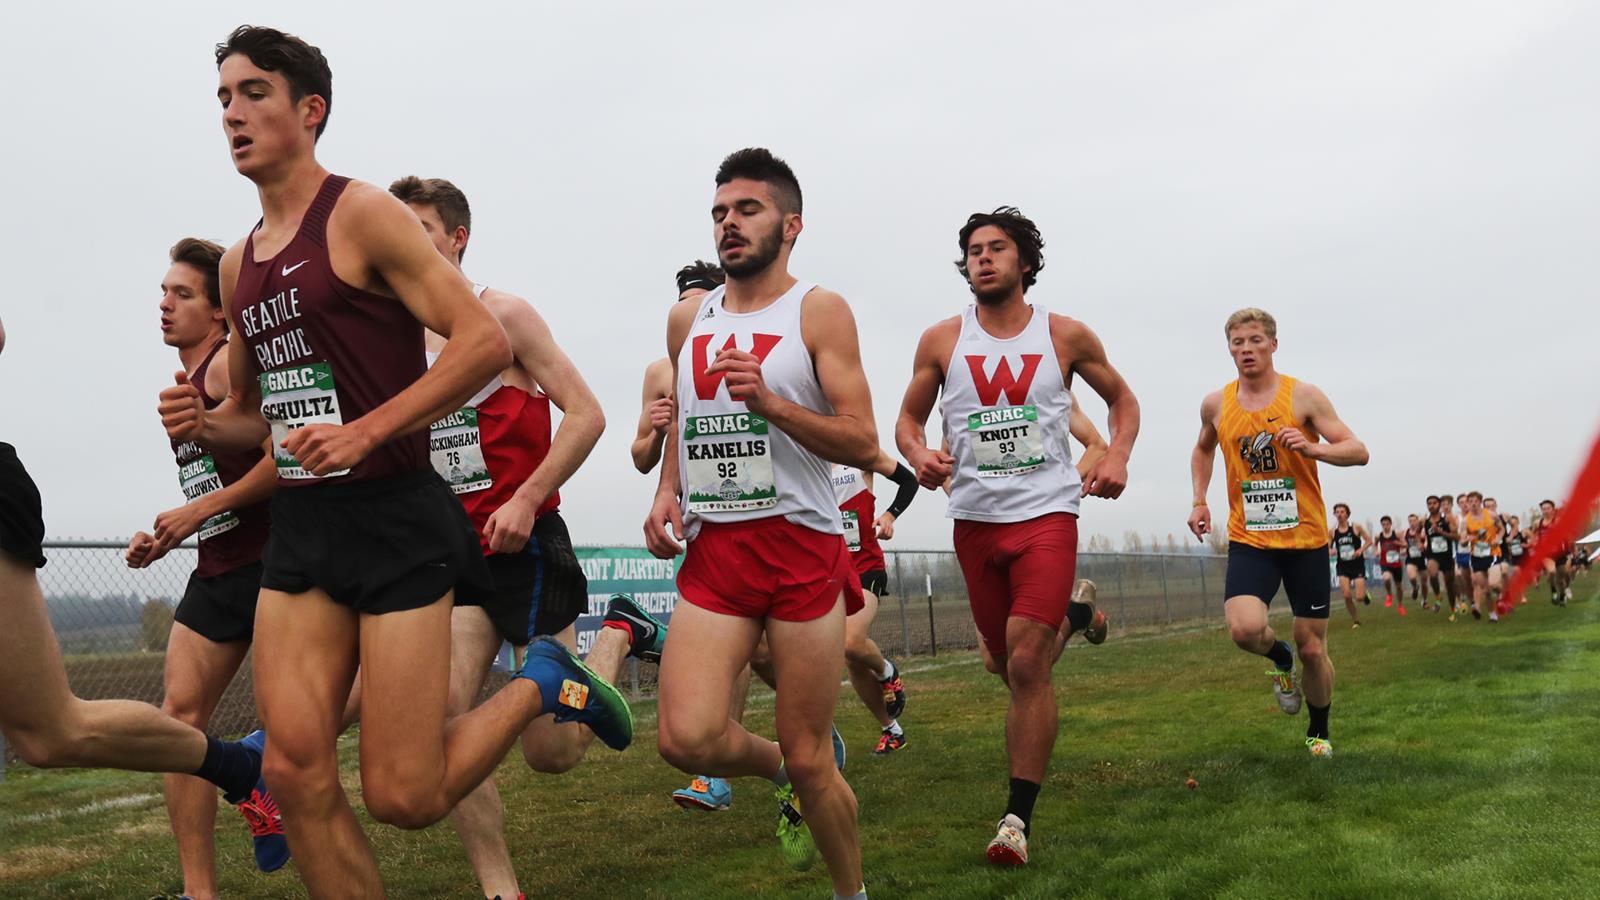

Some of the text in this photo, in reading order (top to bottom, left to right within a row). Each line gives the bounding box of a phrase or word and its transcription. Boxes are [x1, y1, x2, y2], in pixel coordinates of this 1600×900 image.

[241, 287, 301, 338] SEATTLE
[692, 332, 783, 401] W
[267, 367, 315, 391] GNAC
[964, 354, 1044, 406] W
[262, 396, 335, 421] SCHULTZ
[980, 407, 1024, 425] GNAC
[695, 414, 750, 434] GNAC
[979, 425, 1029, 443] KNOTT
[430, 431, 479, 452] UCKINGHAM
[687, 440, 766, 460] KANELIS
[999, 441, 1015, 454] 93
[446, 451, 460, 466] 76
[181, 459, 206, 480] GNAC
[717, 461, 737, 478] 92
[1250, 478, 1285, 490] GNAC
[1245, 492, 1293, 504] VENEMA
[1263, 503, 1276, 513] 47
[579, 558, 611, 580] AINT
